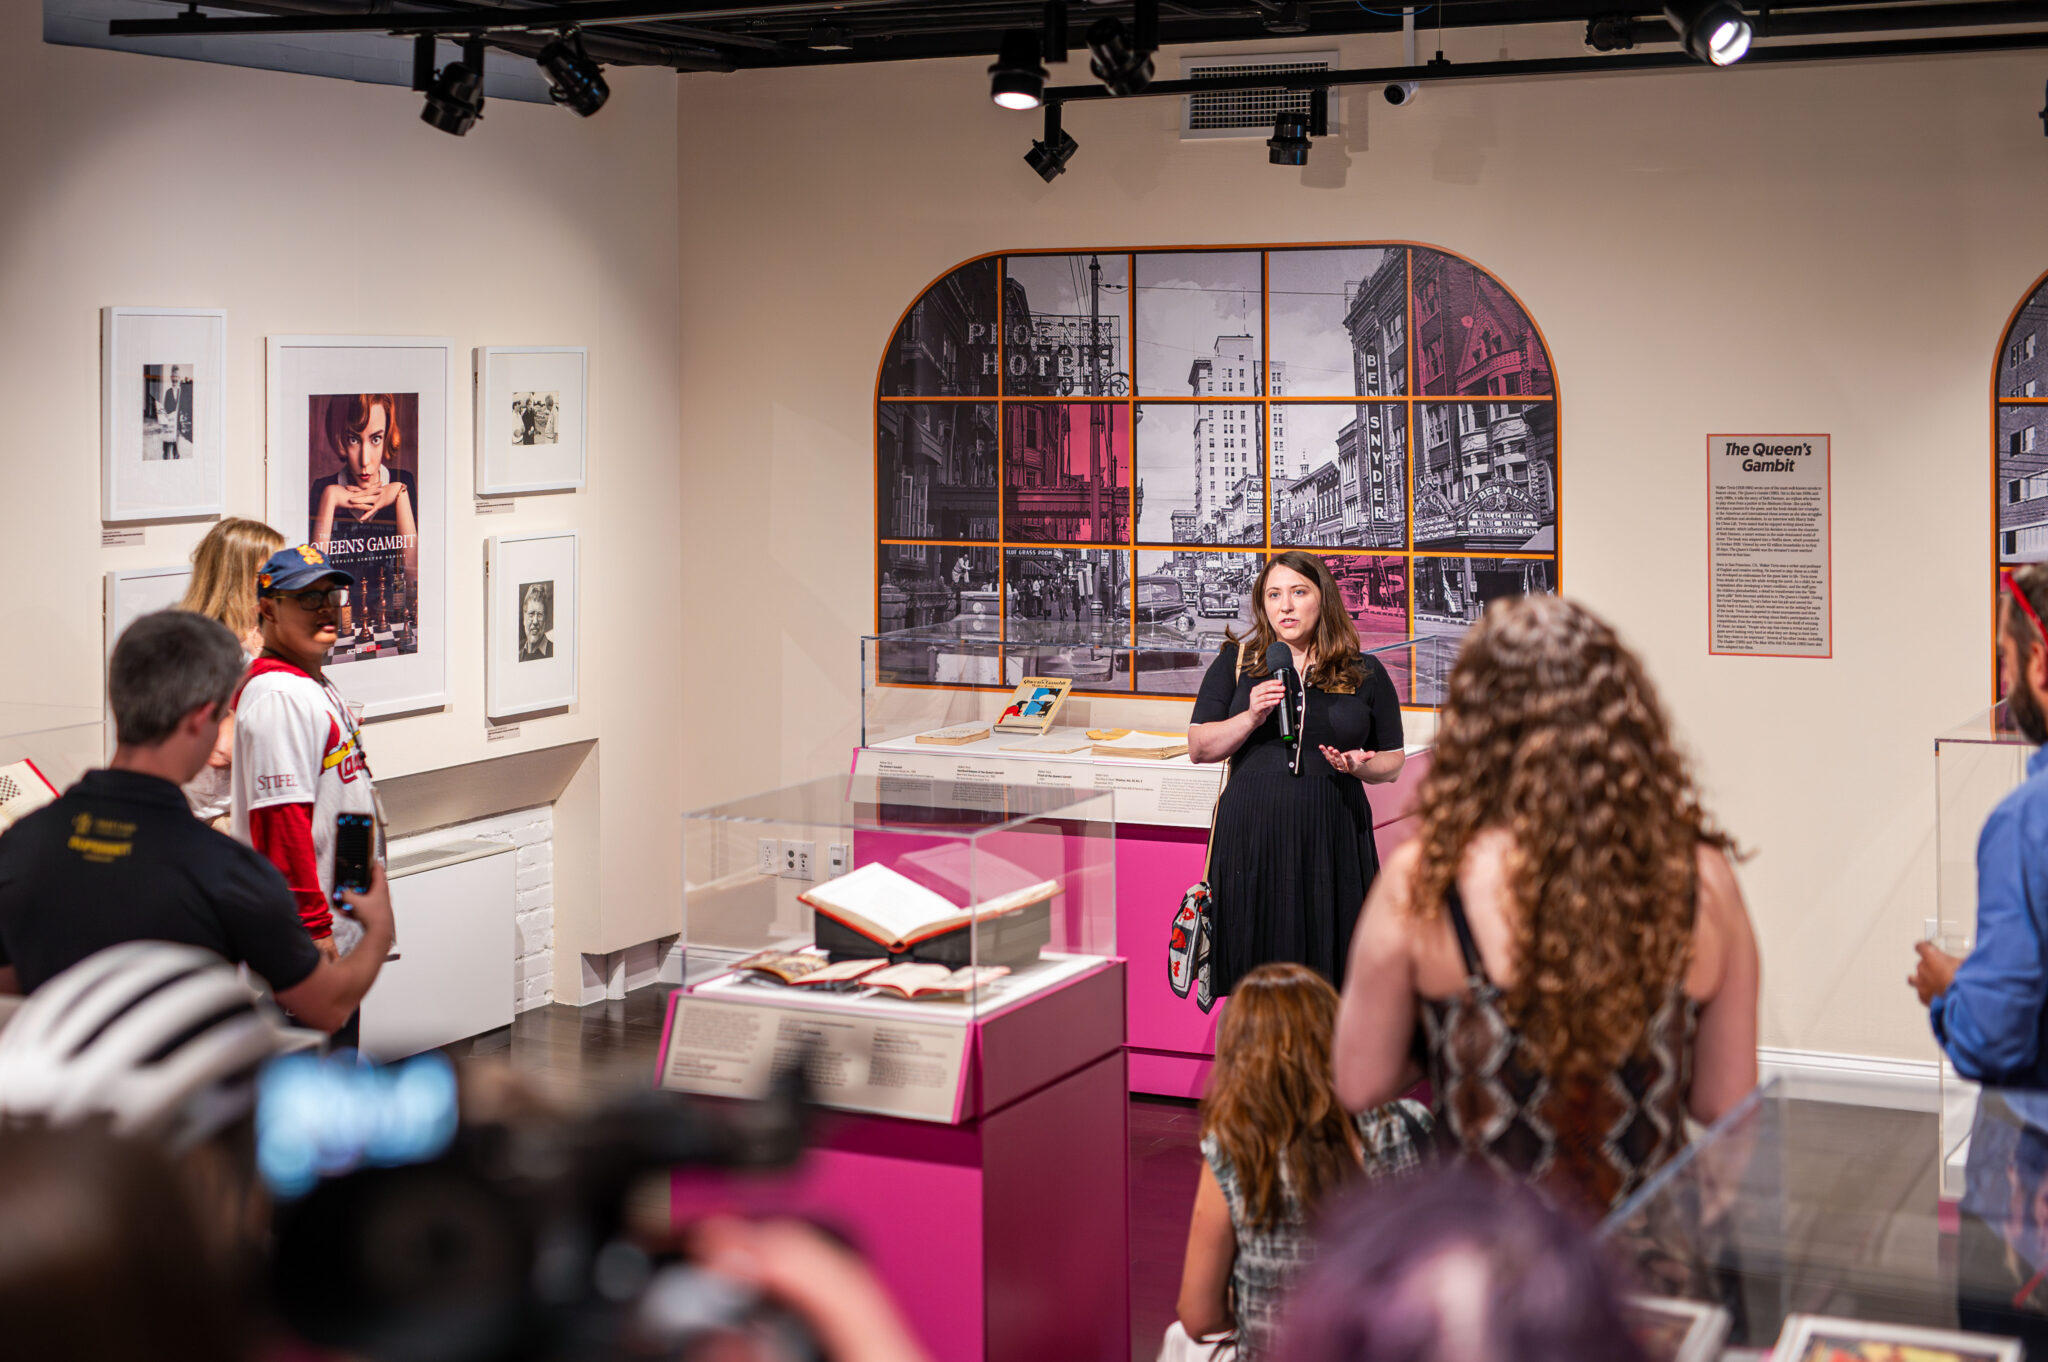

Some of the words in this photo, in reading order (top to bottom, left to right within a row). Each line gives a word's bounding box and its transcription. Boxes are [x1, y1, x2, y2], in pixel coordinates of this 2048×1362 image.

[967, 322, 1112, 345] PHOENIX
[1726, 443, 1750, 456] The
[1753, 443, 1812, 457] Queen's
[1369, 416, 1385, 519] SNYDER
[1742, 459, 1795, 472] Gambit
[1478, 486, 1500, 500] BEN
[1504, 486, 1525, 501] ALI
[366, 534, 416, 552] GAMBIT
[257, 774, 298, 790] STIFEL
